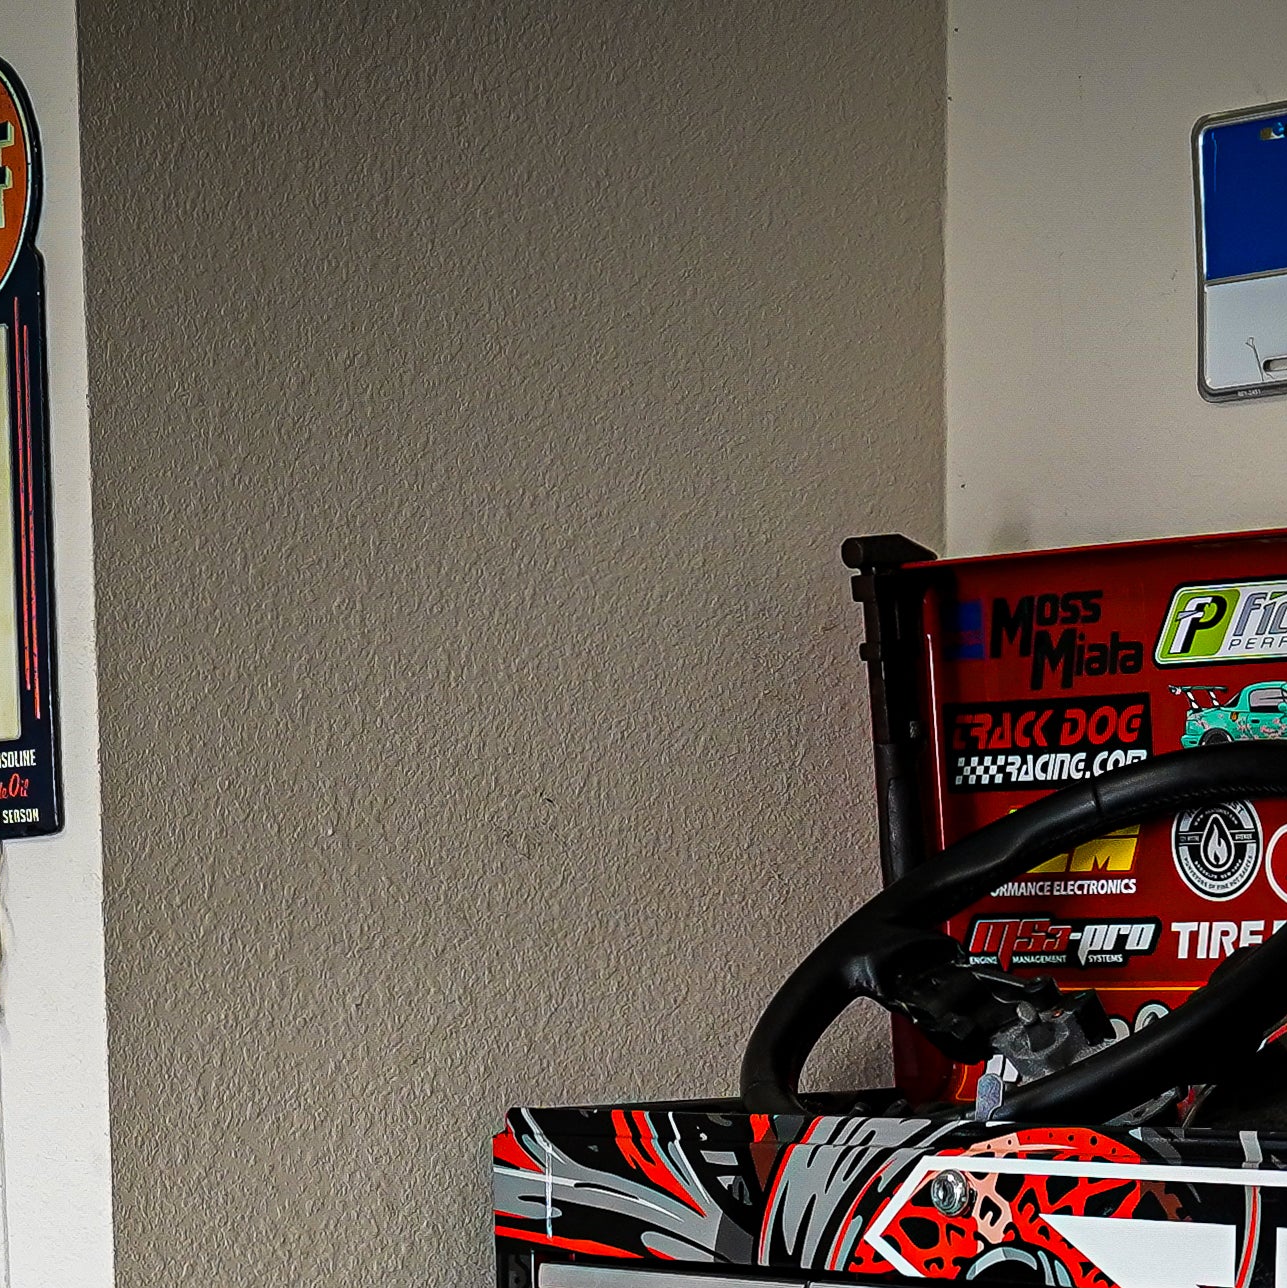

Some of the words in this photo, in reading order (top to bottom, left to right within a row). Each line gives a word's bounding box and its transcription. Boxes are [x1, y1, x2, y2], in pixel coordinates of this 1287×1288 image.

[990, 590, 1103, 658] Moss
[1030, 628, 1144, 691] Miata
[1059, 704, 1145, 746] DOG
[990, 882, 1051, 897] RMANCE
[1053, 879, 1137, 895] ELECTRONICS
[1012, 955, 1067, 963] MANAGEMENT
[1088, 954, 1123, 963] SYSTEMS
